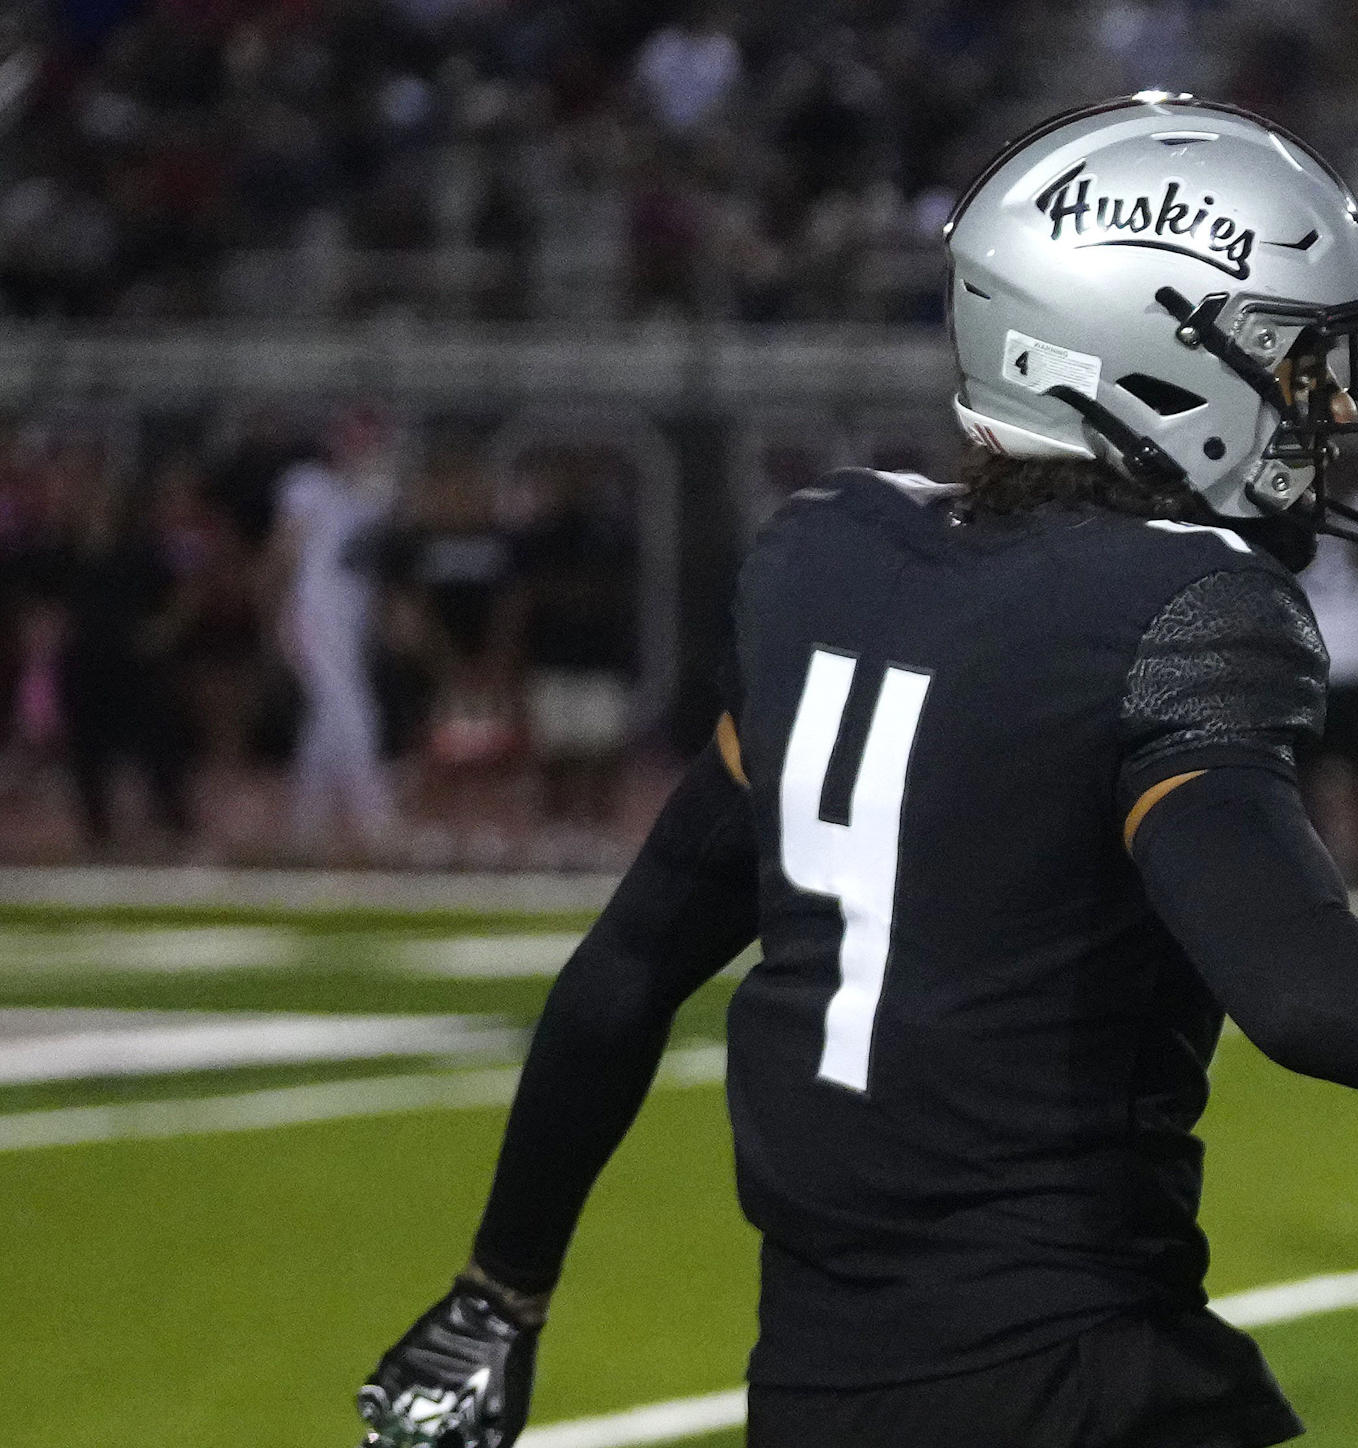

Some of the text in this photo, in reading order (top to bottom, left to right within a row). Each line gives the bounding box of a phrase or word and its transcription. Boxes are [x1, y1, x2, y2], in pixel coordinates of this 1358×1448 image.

[1049, 178, 1256, 281] Huskies
[1014, 350, 1029, 376] 4
[779, 648, 935, 1094] 4
